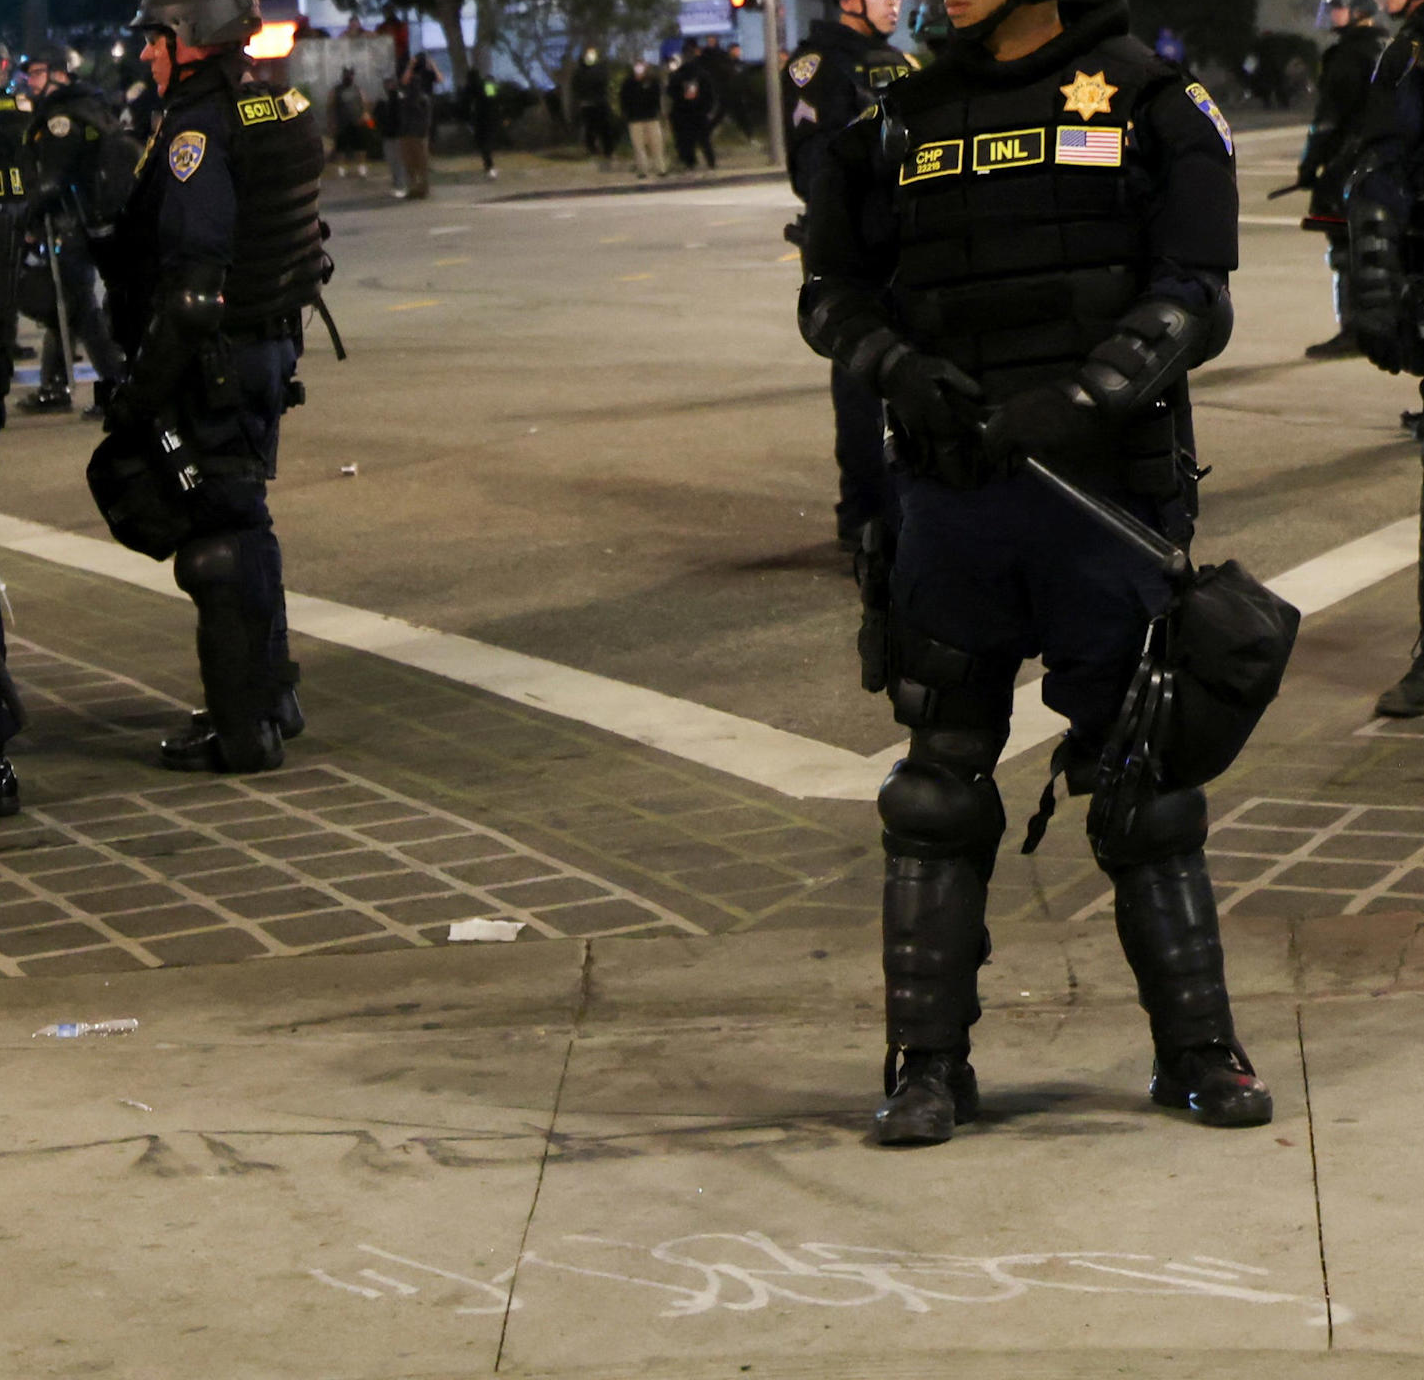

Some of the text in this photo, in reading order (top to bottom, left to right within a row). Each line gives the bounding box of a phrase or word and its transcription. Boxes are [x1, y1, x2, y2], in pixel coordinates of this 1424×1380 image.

[244, 101, 271, 119] SOU
[915, 148, 943, 165] CHP
[990, 139, 1028, 161] INL
